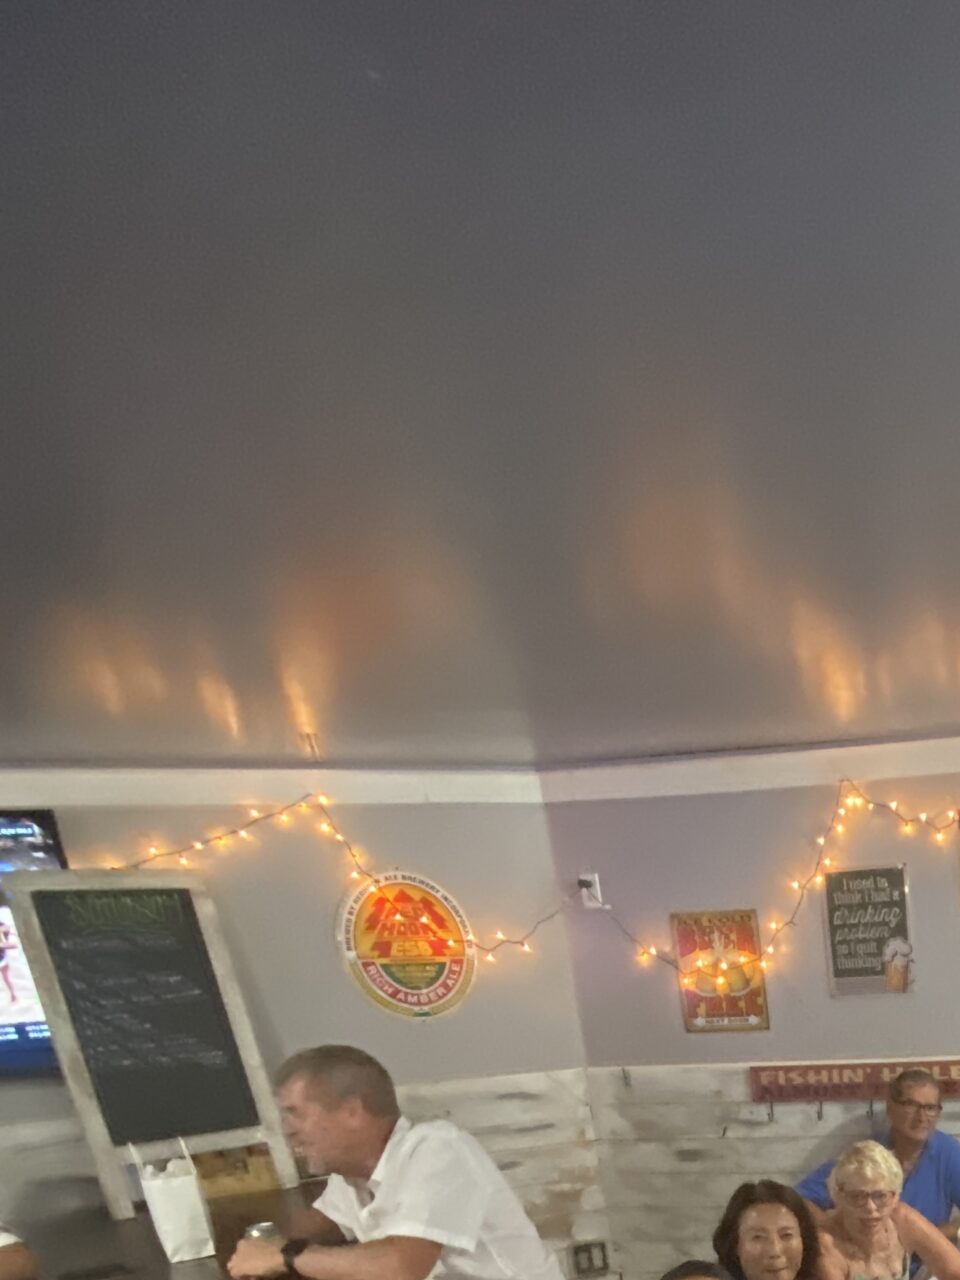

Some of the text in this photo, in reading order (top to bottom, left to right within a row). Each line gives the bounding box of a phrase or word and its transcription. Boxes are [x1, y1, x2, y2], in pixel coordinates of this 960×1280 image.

[401, 874, 440, 894] BREWERY
[849, 875, 875, 889] used
[833, 890, 863, 905] think
[870, 887, 891, 902] had
[833, 904, 903, 928] drinking
[834, 923, 891, 943] problem
[835, 943, 849, 956] so
[856, 940, 878, 957] quit
[836, 956, 884, 971] thinking
[366, 964, 395, 994] RICH
[396, 987, 447, 1005] AMBER
[447, 963, 462, 986] ALE
[760, 1066, 872, 1086] FISHIN'
